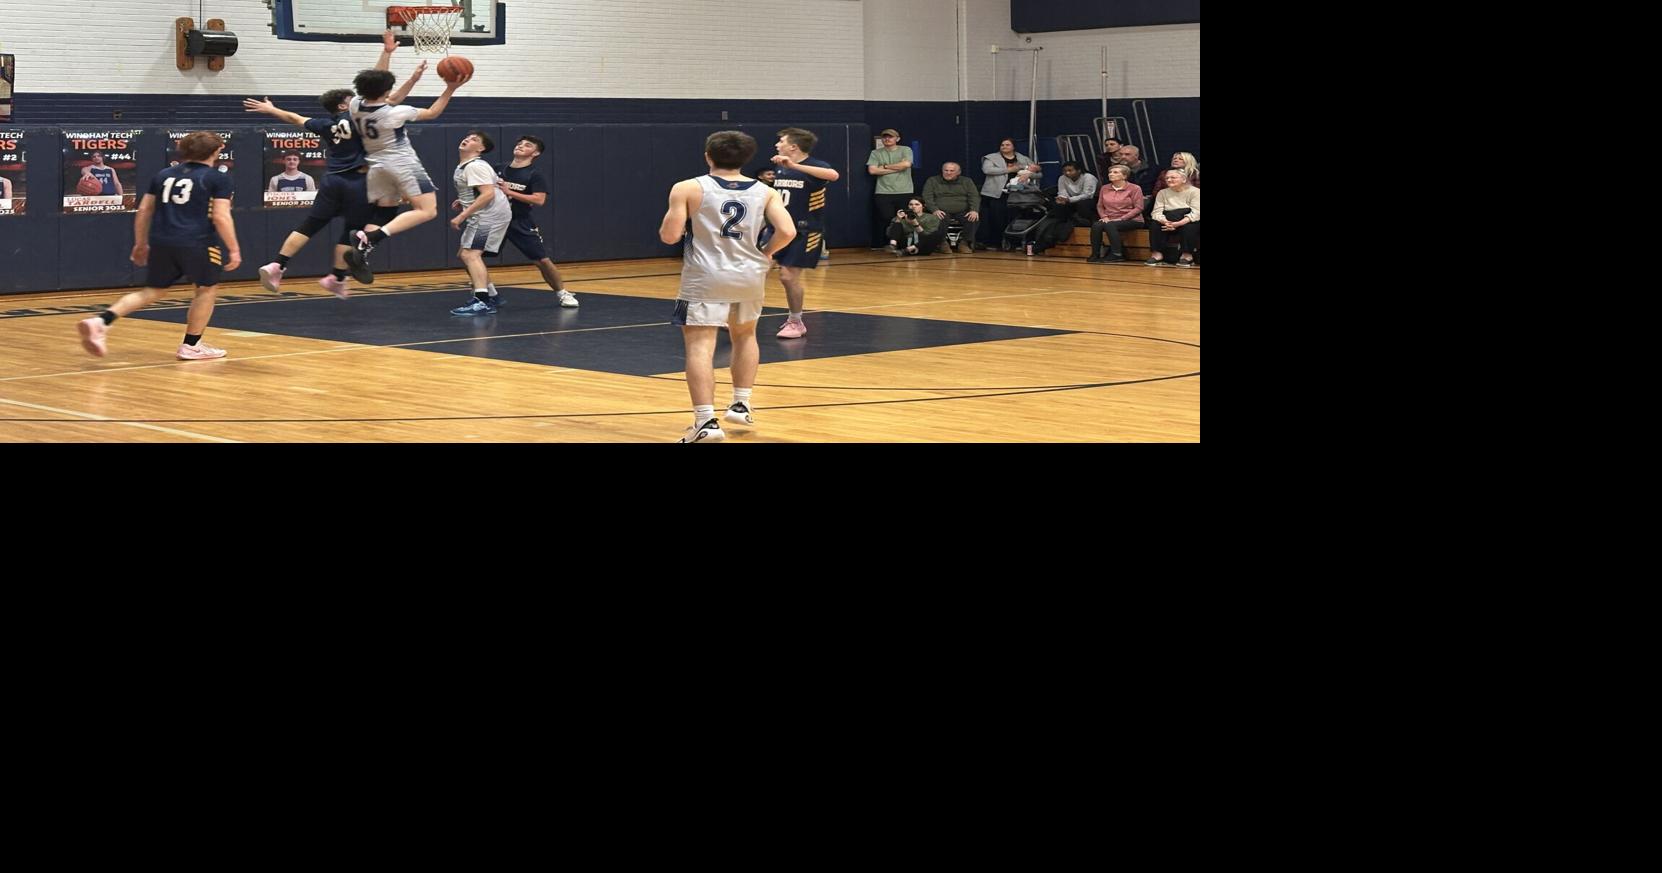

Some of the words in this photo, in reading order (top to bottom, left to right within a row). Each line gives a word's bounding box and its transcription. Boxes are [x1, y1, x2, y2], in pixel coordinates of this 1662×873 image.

[72, 139, 129, 150] TIGERS
[271, 139, 320, 149] TIGERS
[162, 177, 194, 205] 13
[720, 200, 748, 240] 2
